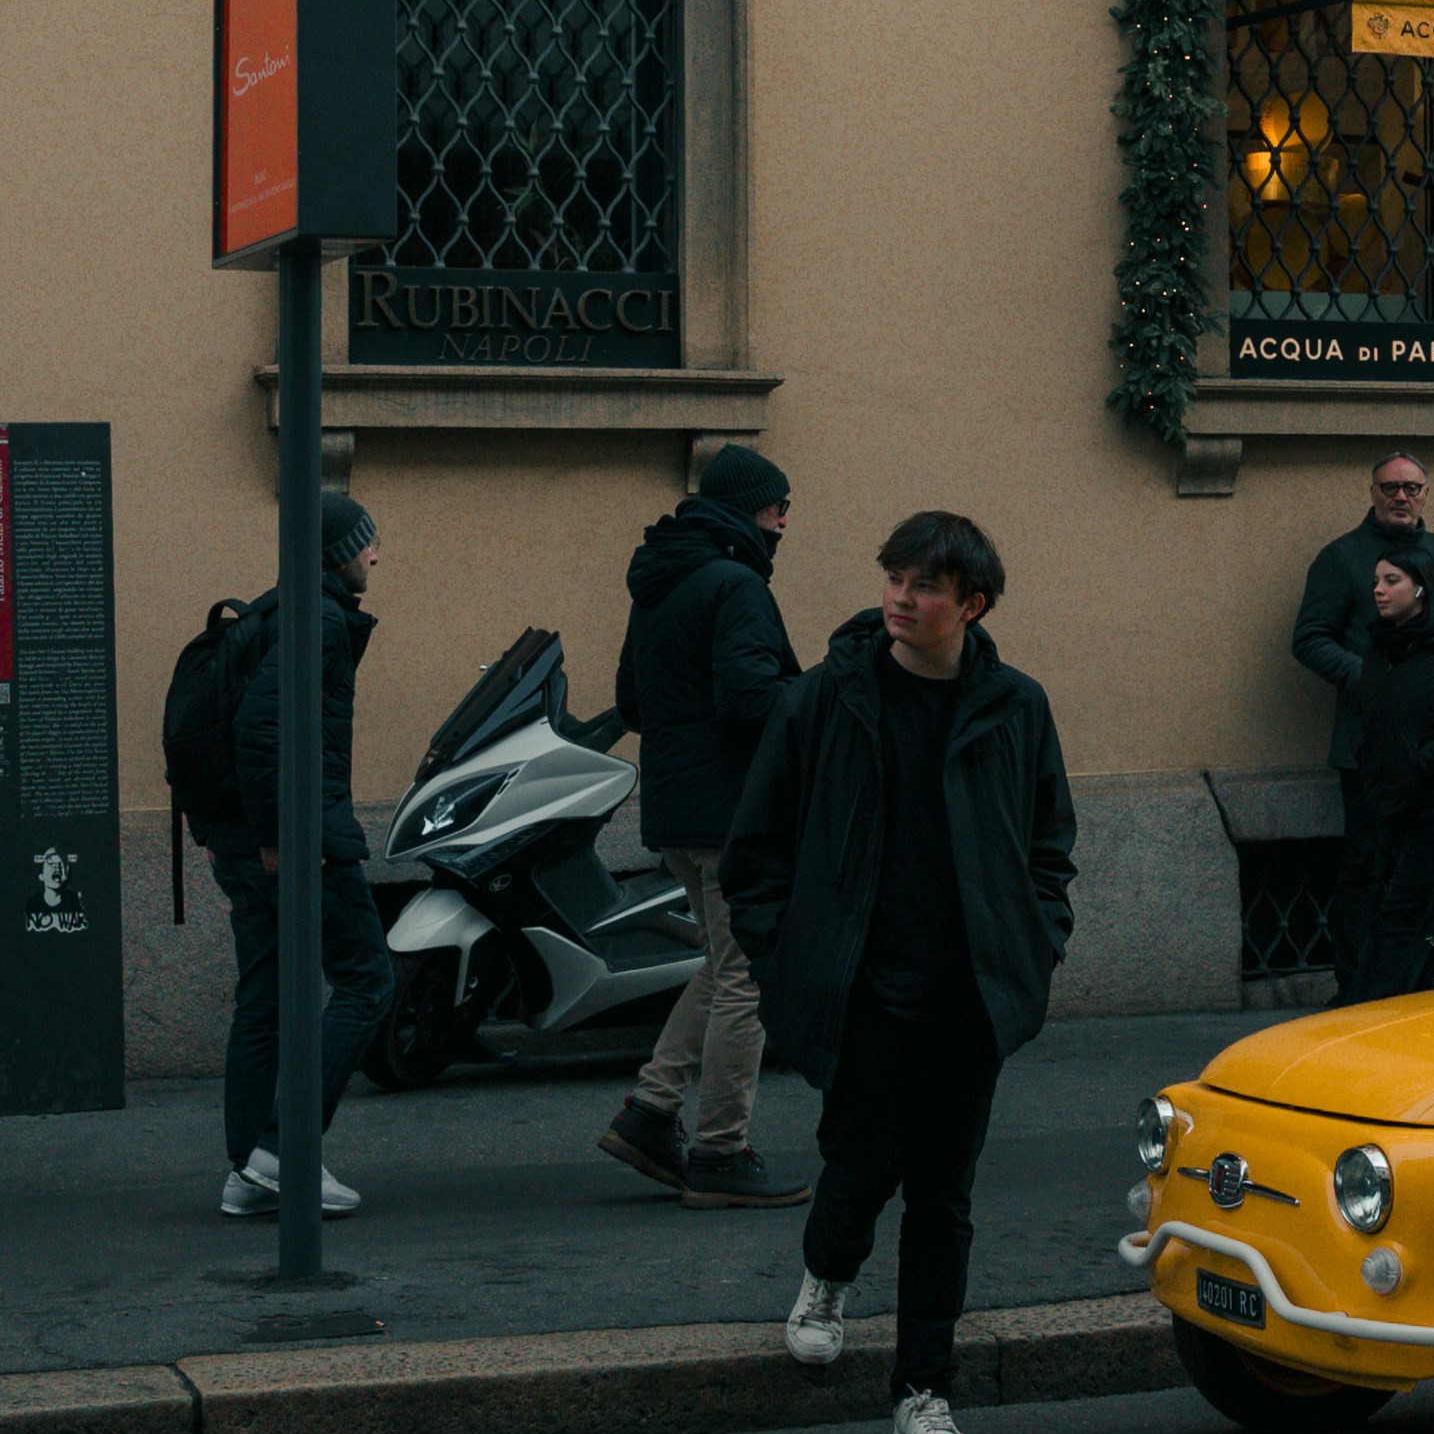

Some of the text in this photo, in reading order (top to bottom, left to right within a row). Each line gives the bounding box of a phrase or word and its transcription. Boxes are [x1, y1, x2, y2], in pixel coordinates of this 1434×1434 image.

[232, 44, 292, 97] Santoni
[437, 333, 595, 363] NAPOLI
[1238, 336, 1344, 362] ACQUA
[26, 911, 53, 930] NO
[1240, 1290, 1257, 1318] RC
